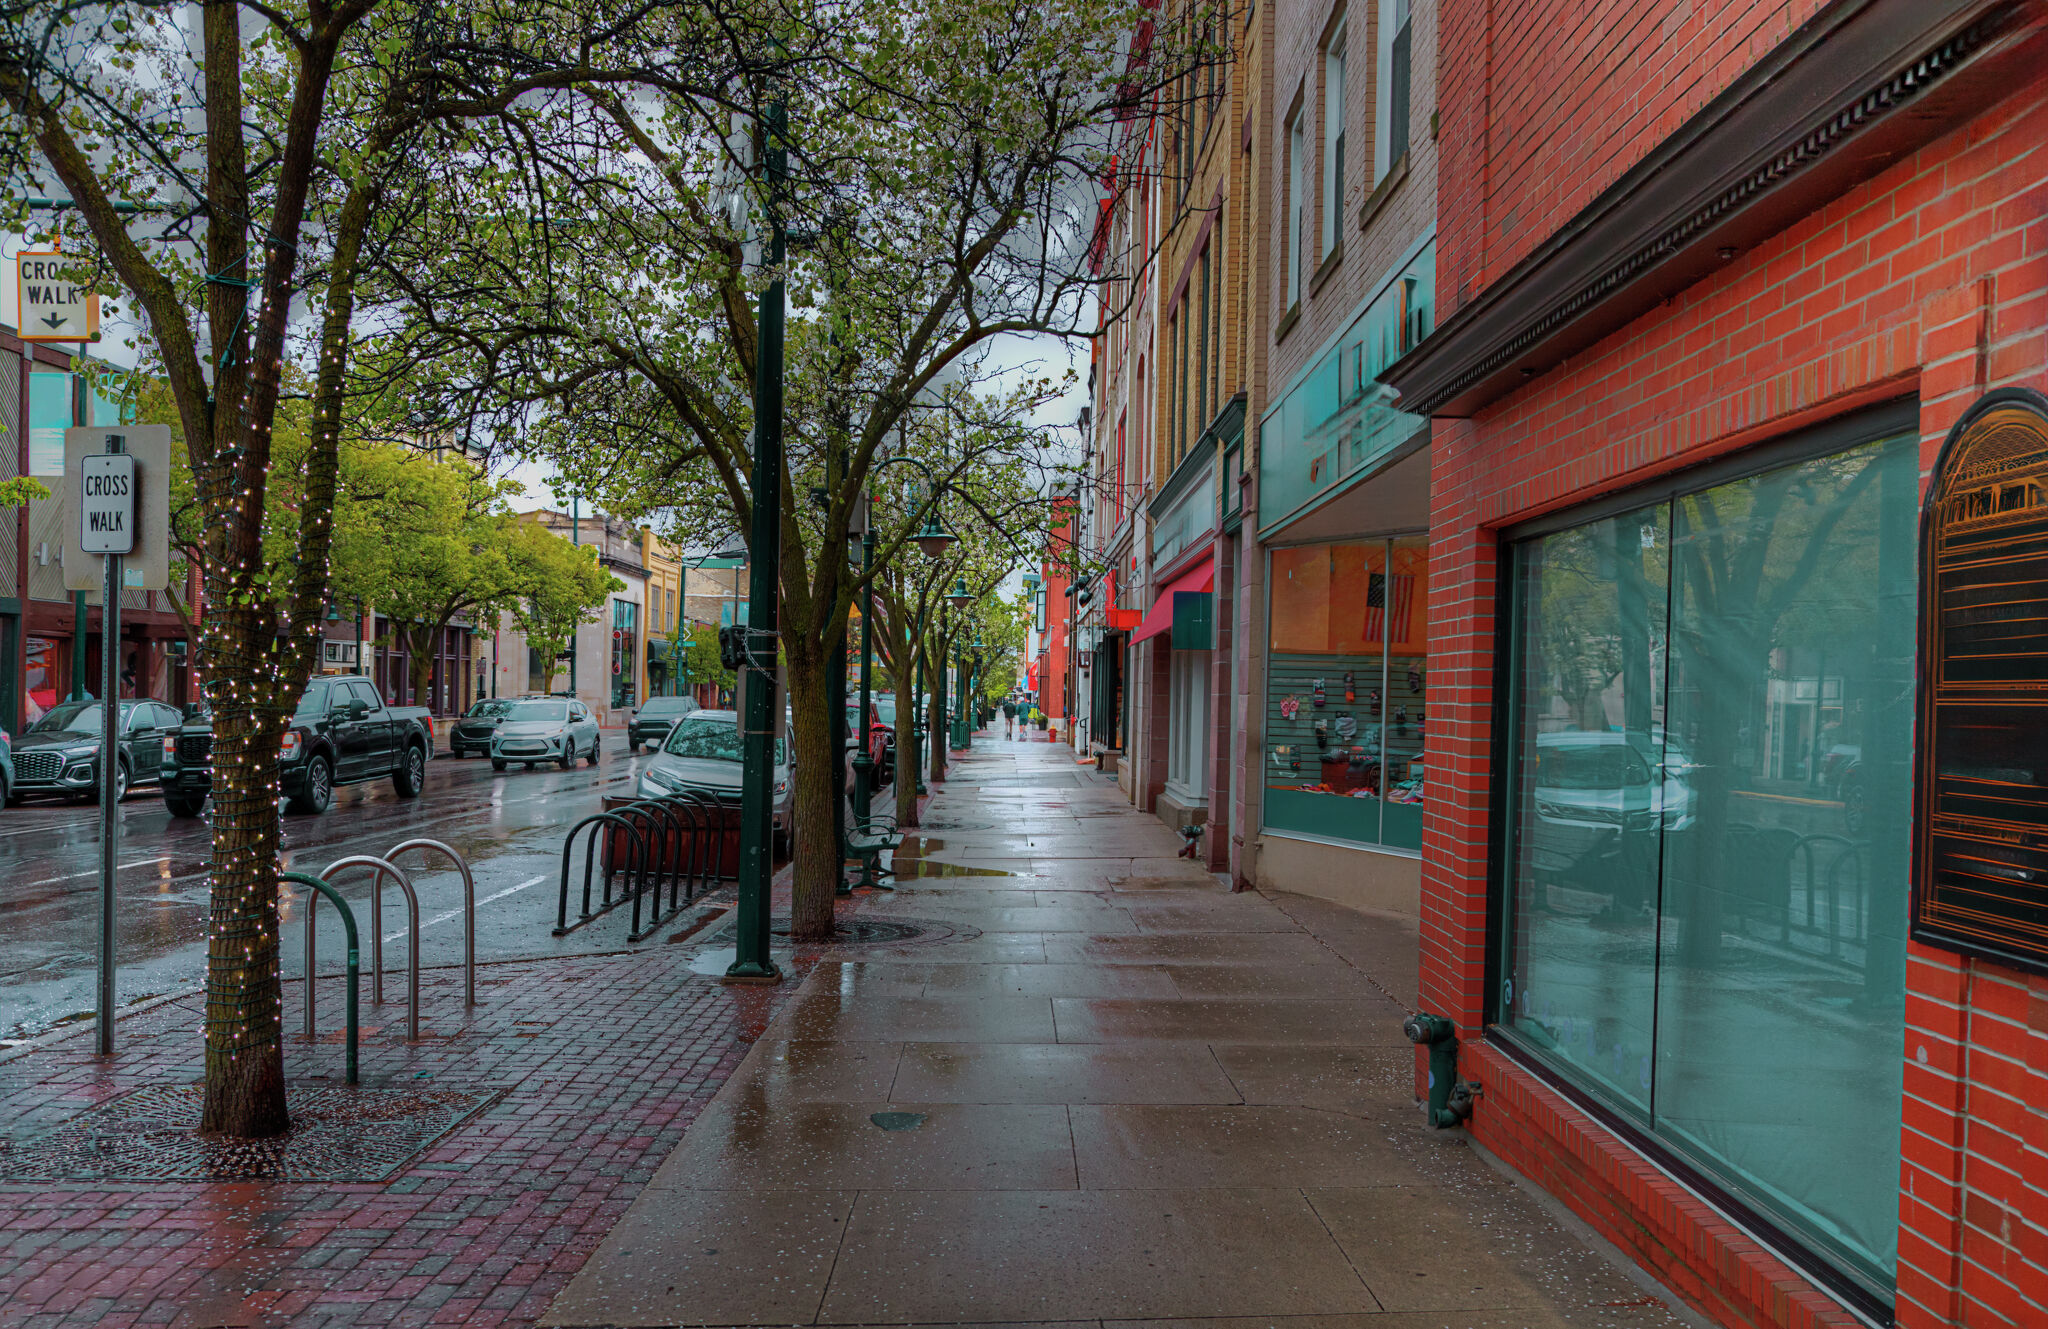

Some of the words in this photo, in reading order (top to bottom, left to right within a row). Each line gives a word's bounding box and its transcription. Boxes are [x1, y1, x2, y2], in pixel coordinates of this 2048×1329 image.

[21, 261, 71, 280] CRO
[27, 286, 79, 305] WALK
[86, 474, 128, 496] CROSS
[90, 511, 123, 532] WALK
